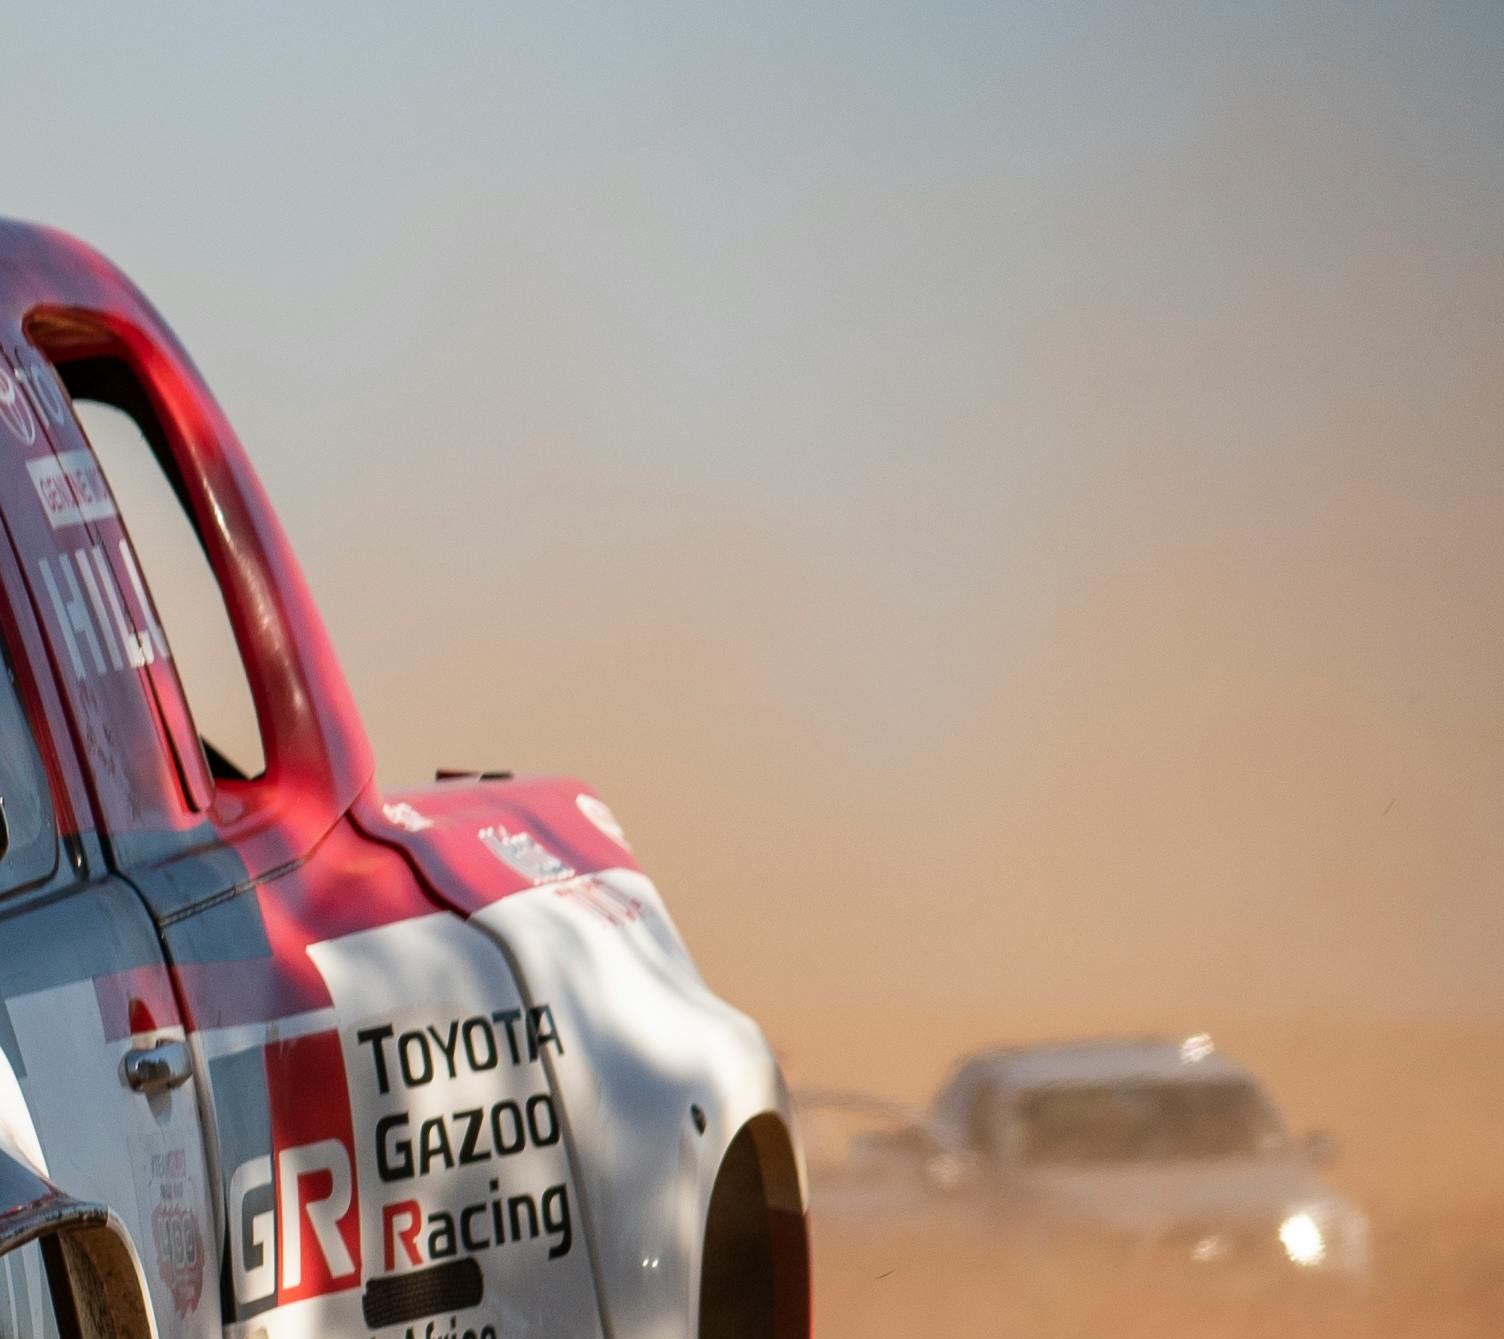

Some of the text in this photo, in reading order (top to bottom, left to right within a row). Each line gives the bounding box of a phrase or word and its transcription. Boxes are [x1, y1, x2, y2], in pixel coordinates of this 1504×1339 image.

[356, 1004, 566, 1096] TOYOTA
[374, 1093, 563, 1184] GAZOO
[228, 1138, 359, 1304] GR
[382, 1179, 574, 1274] Racing
